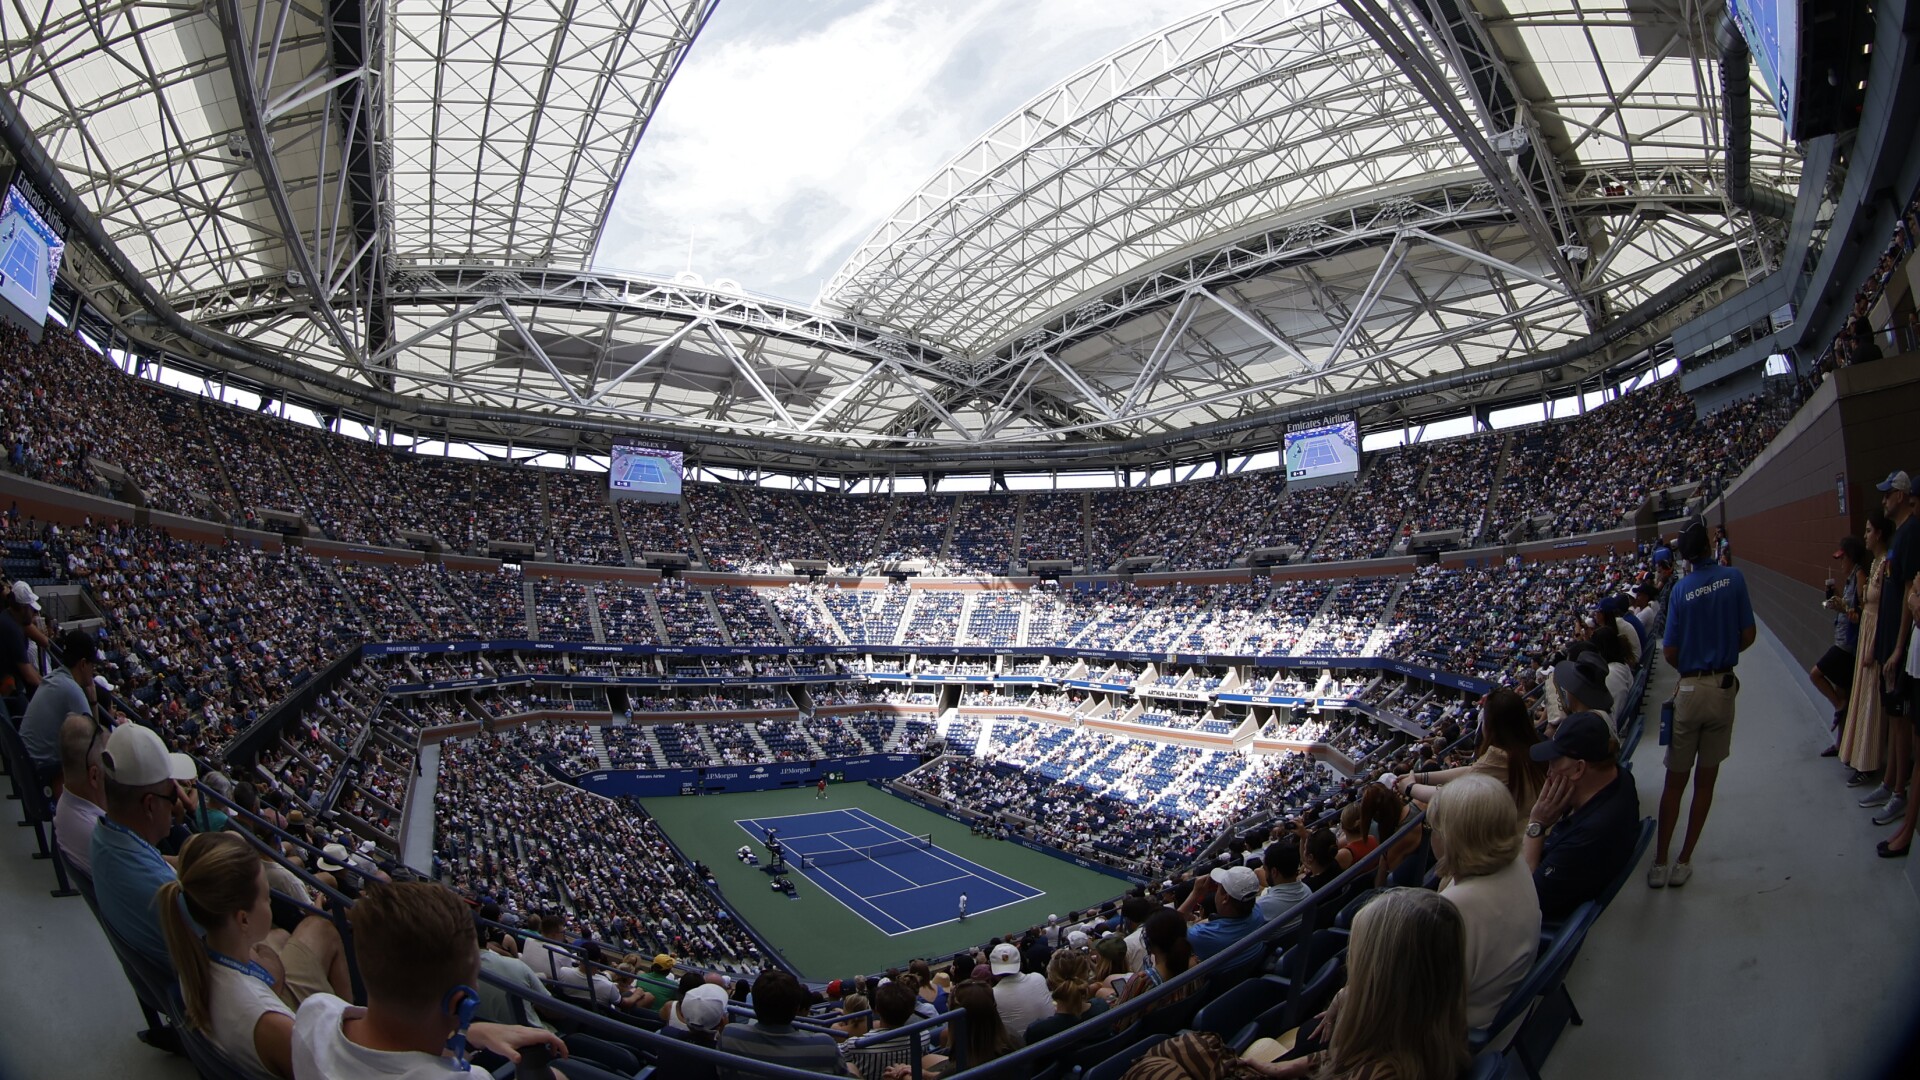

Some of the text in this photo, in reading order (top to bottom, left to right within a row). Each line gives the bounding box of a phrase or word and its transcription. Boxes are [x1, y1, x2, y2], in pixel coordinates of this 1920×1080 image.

[16, 170, 67, 239] Emirates Airline
[1287, 413, 1350, 432] Emirates Airline
[1685, 578, 1730, 601] US OPEN STAFF
[1395, 664, 1412, 673] CADILLAC
[705, 772, 738, 780] J.P.Morgan
[780, 767, 811, 775] J.P.Morgan
